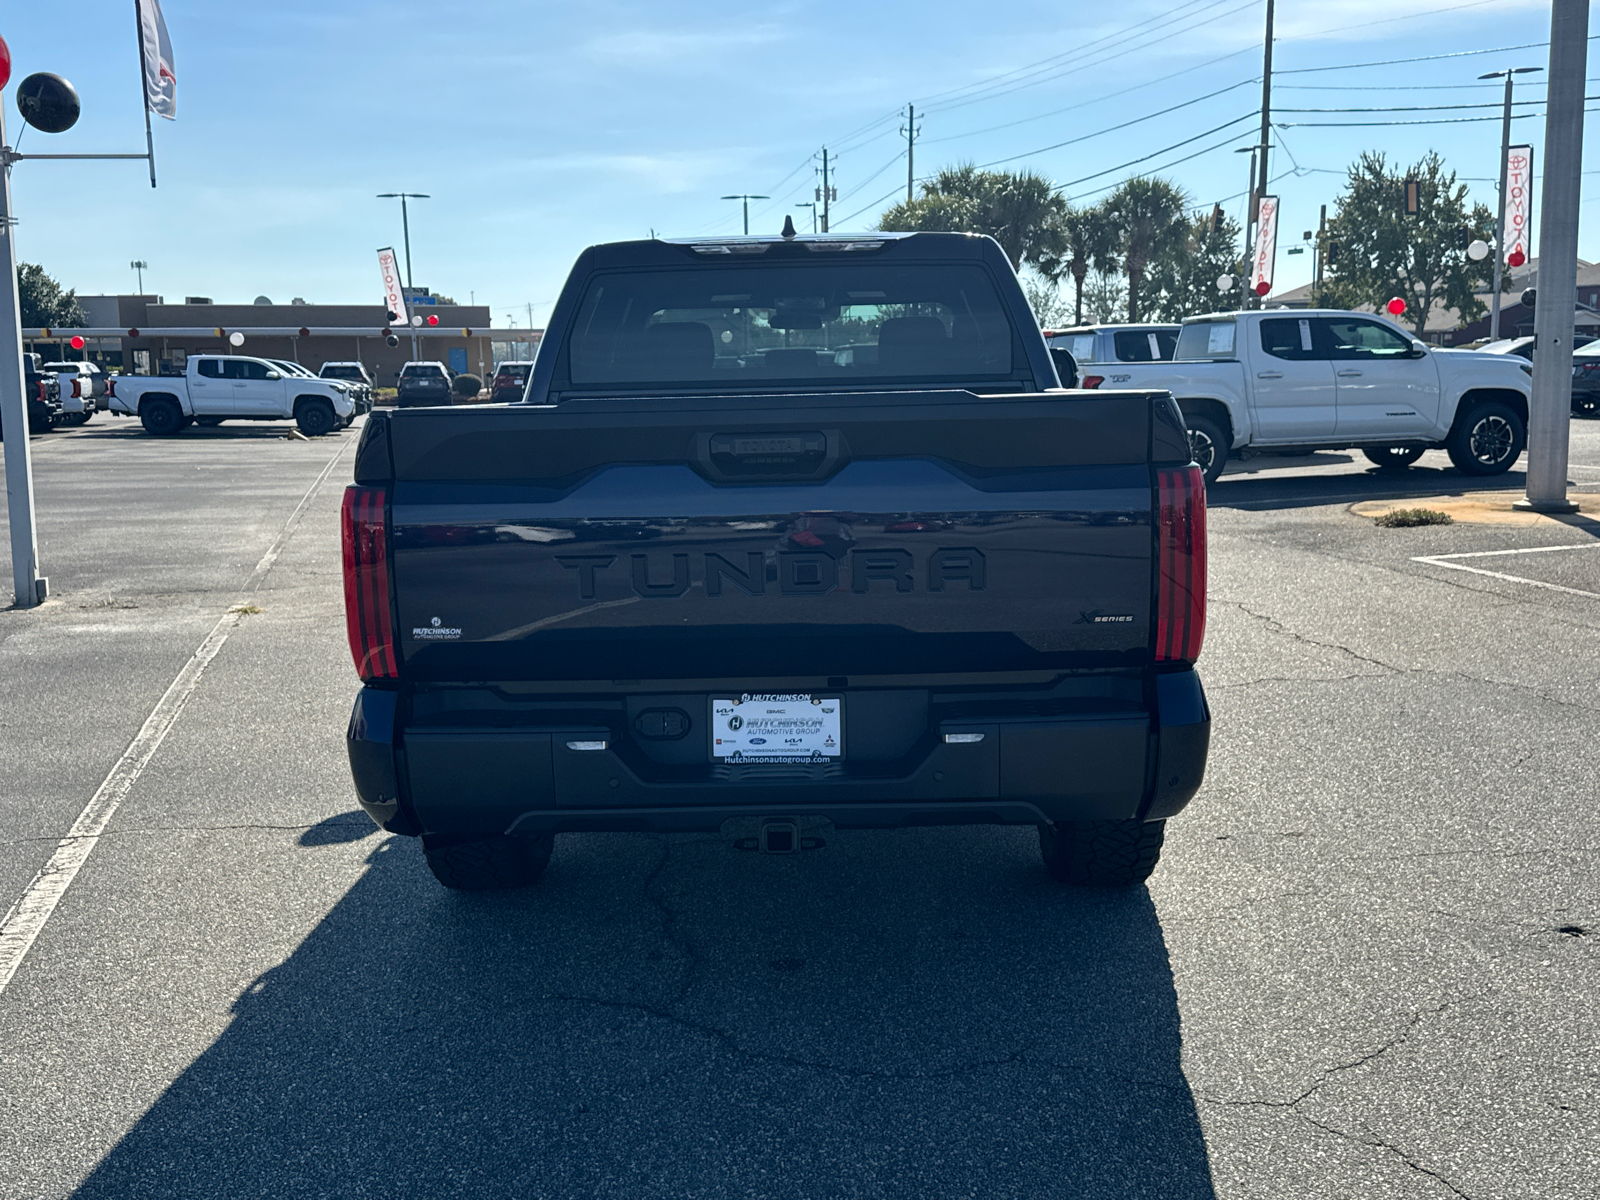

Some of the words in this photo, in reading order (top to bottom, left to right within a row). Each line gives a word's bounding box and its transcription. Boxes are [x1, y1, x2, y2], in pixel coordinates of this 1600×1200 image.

[741, 440, 795, 451] TOYOTA
[553, 546, 987, 600] TUNDRA
[413, 627, 462, 635] HUTCHINSON
[752, 694, 811, 702] HUTCHINSON
[746, 718, 824, 729] HUTCHINSON
[724, 756, 831, 765] Hutchinsonautogroup.com
